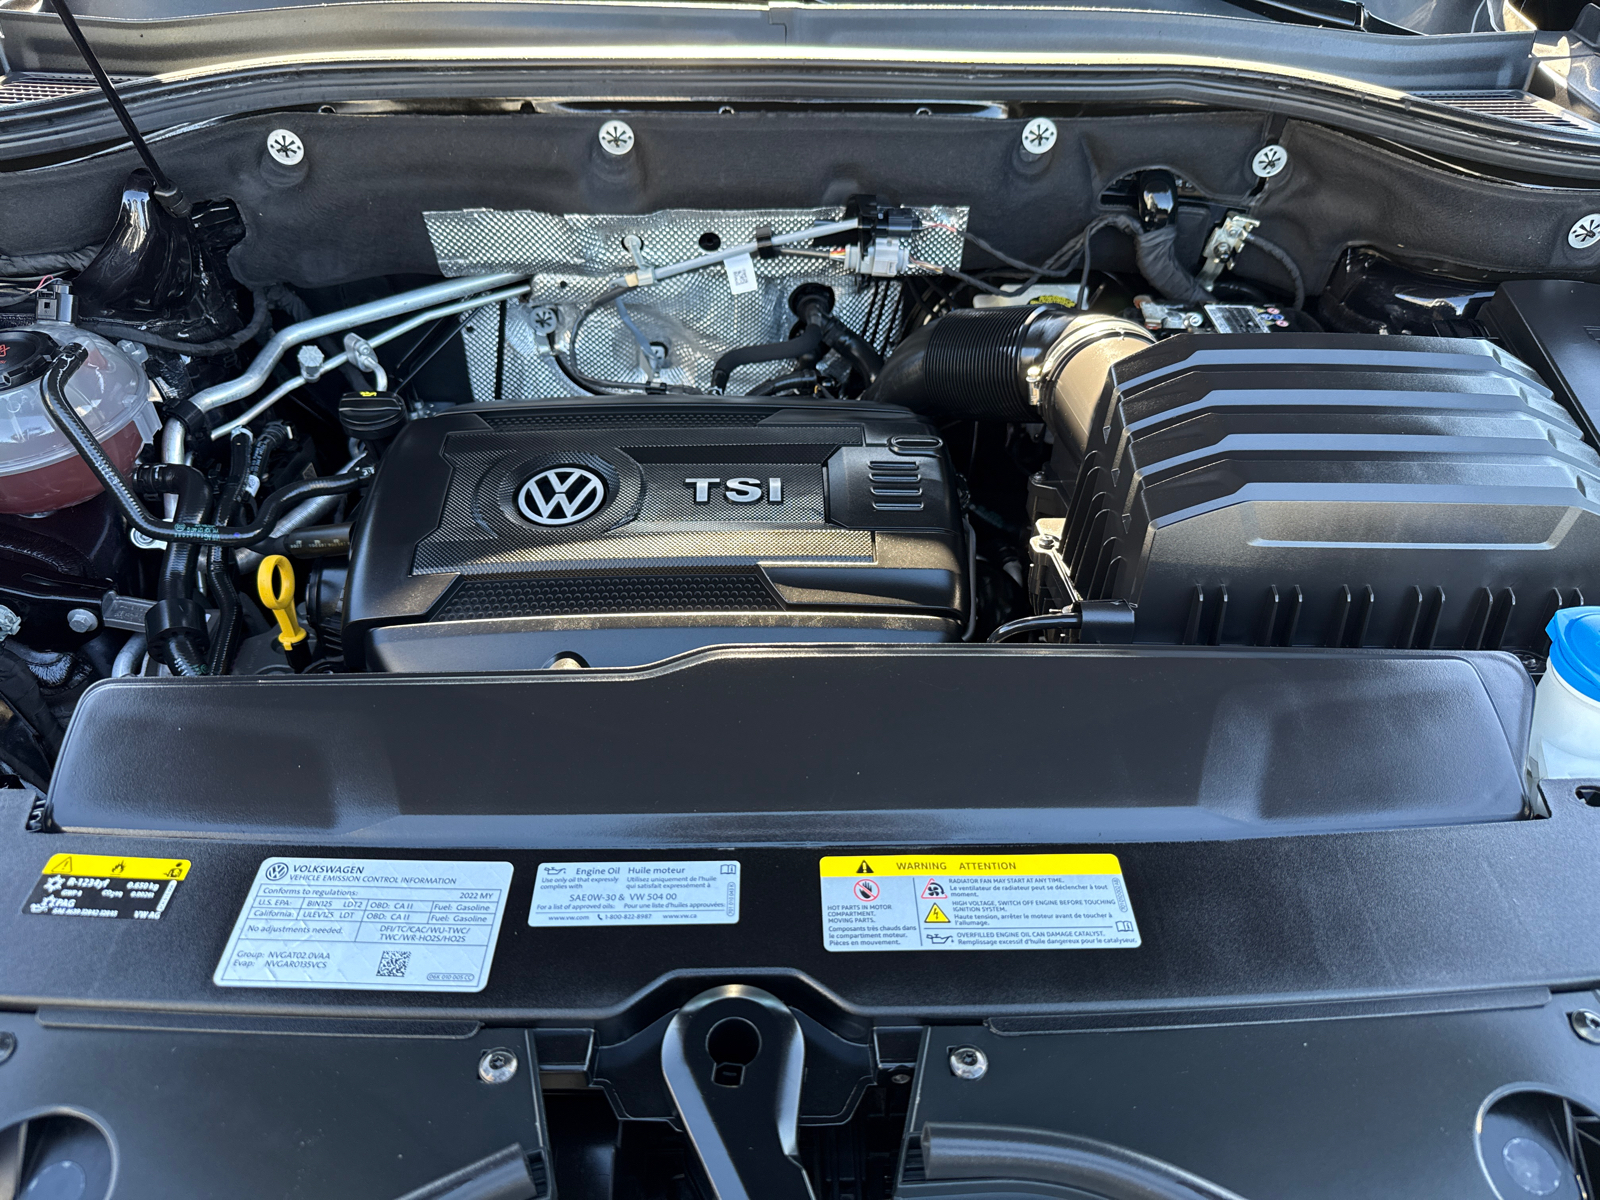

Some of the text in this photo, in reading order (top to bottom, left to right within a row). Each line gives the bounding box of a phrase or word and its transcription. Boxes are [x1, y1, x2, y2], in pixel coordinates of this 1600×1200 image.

[684, 477, 783, 505] TSI
[518, 467, 604, 526] VW
[293, 865, 364, 874] VOLKSWAGEN
[896, 862, 1016, 870] WARNING ATTENTION
[576, 867, 606, 877] Engine
[608, 867, 620, 875] Oil
[363, 876, 398, 884] CONTROL
[401, 876, 457, 885] INFORMATION
[263, 887, 301, 895] Conforms
[312, 889, 358, 897] regulations:
[570, 894, 617, 902] SAE0W-30
[134, 911, 161, 920] VW AG
[254, 910, 294, 918] California:
[366, 912, 387, 920] OBD:
[453, 915, 488, 923] Gasoline
[260, 925, 310, 934] adjustments
[380, 925, 471, 934] DFI/TC/CAC/WU-TWC/
[237, 950, 331, 960] Group: NVGAT02.0VAA
[233, 960, 327, 968] Evap: NVGAR0135VCS
